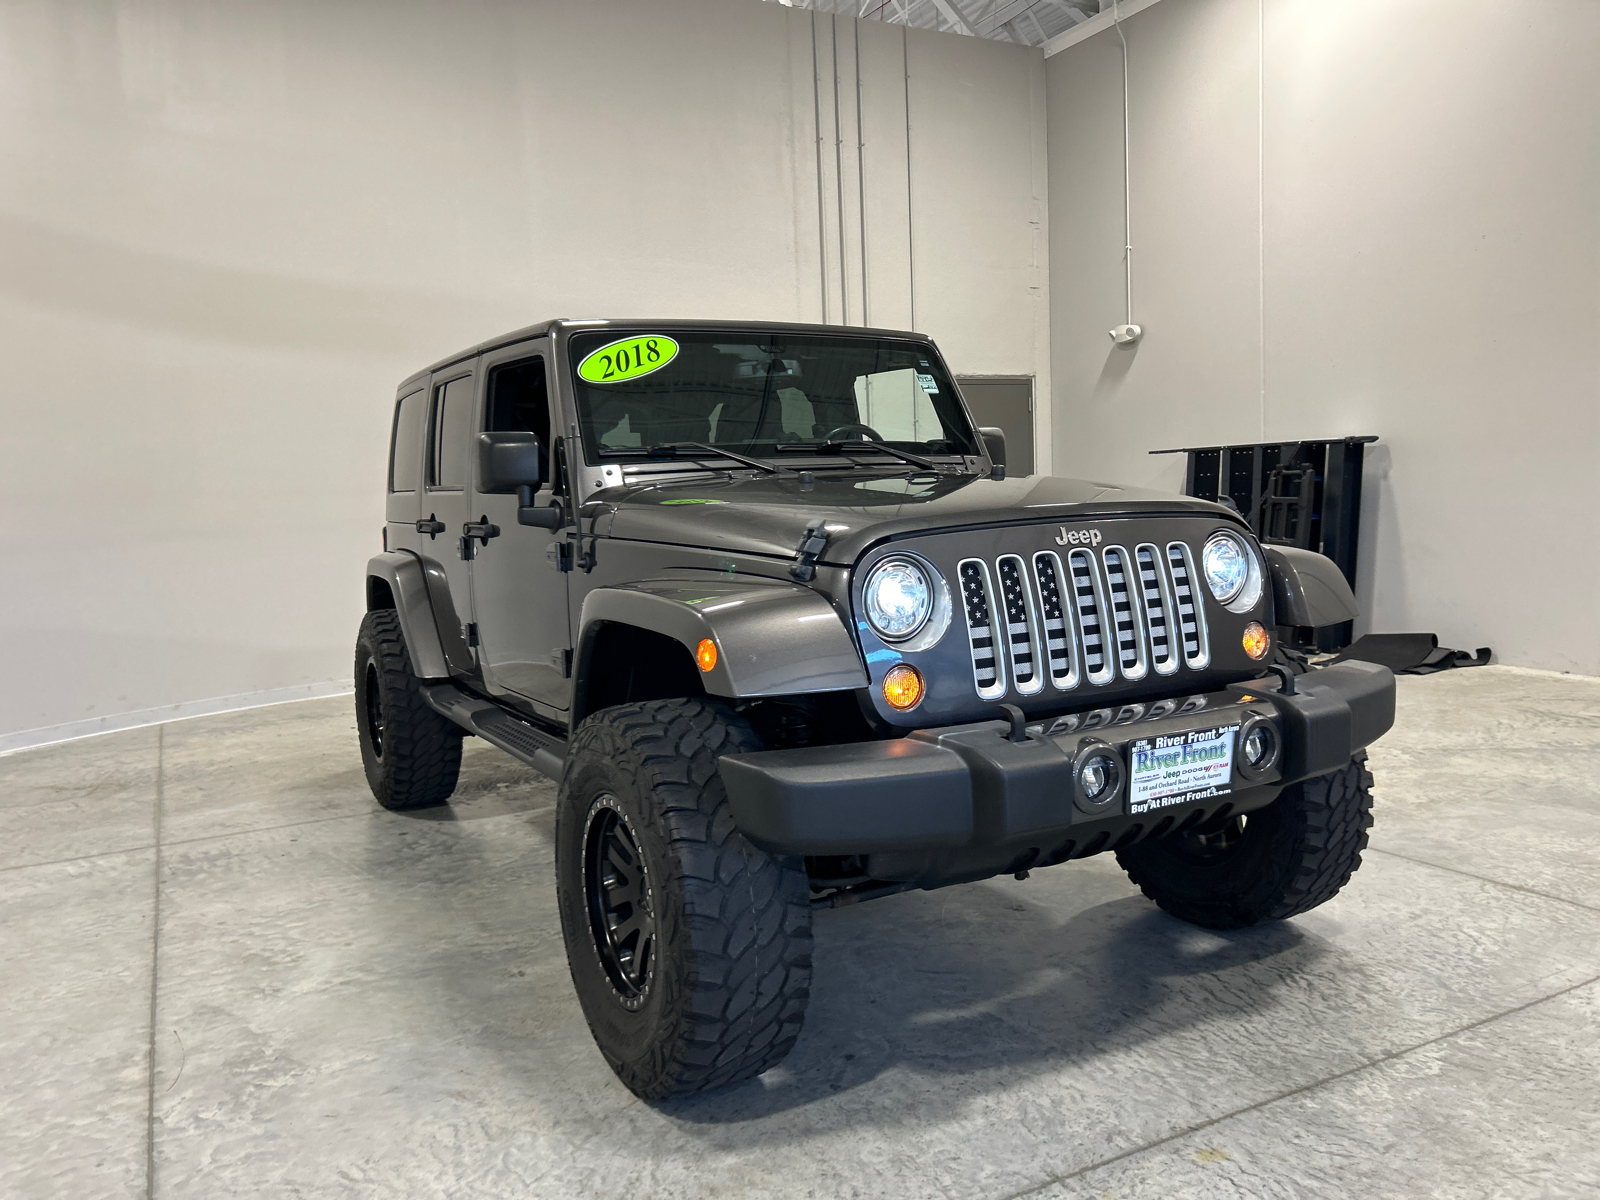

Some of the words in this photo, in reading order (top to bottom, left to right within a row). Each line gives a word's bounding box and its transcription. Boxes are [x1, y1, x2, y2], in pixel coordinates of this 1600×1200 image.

[599, 340, 660, 379] 2018
[1055, 526, 1102, 547] Jeep
[1156, 736, 1186, 749] River
[1187, 729, 1216, 744] Front
[1158, 780, 1178, 789] Orchard
[1178, 777, 1190, 785] Road
[1193, 774, 1207, 782] North
[1162, 770, 1181, 779] Jeep
[1131, 802, 1149, 814] Buy
[1149, 799, 1161, 809] At
[1161, 795, 1186, 807] River
